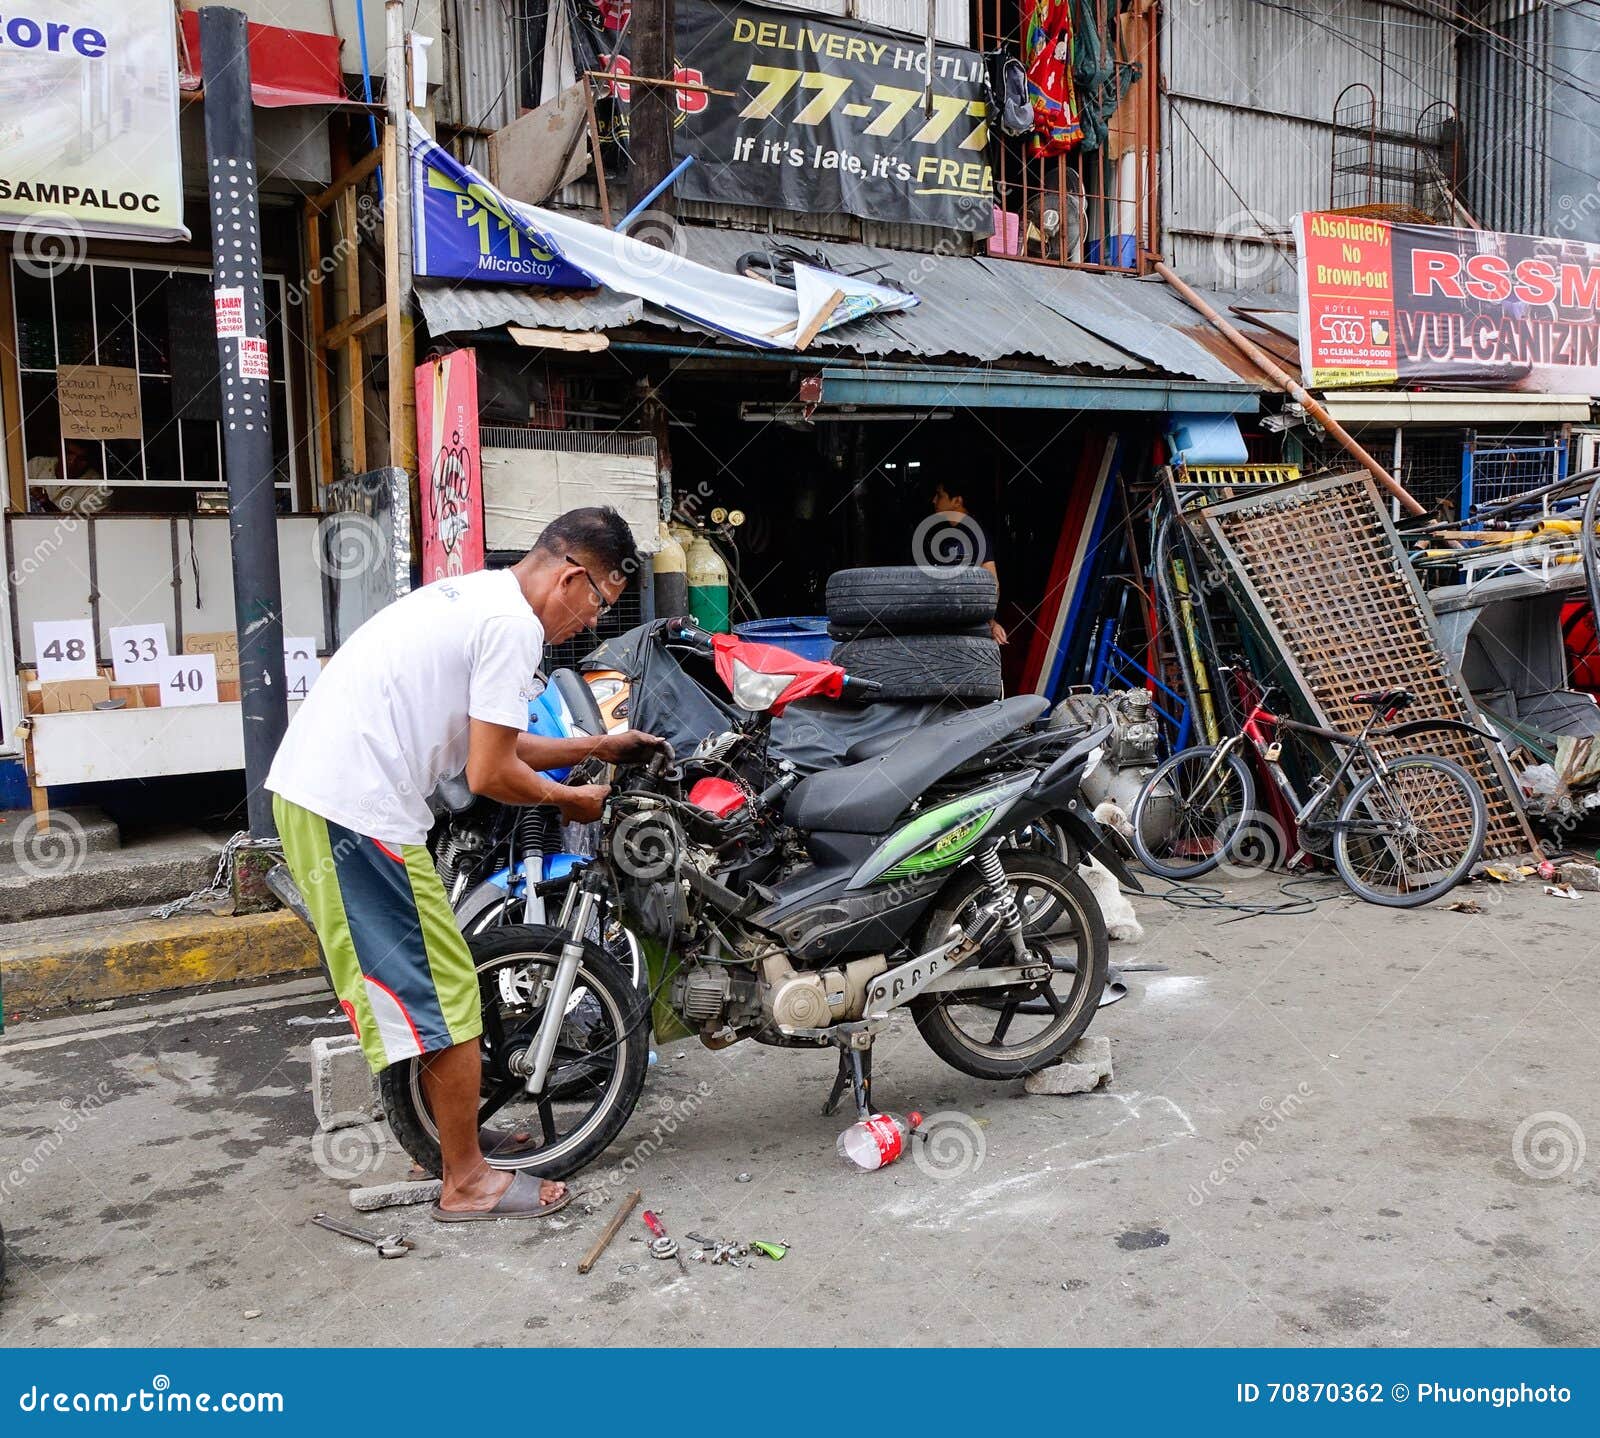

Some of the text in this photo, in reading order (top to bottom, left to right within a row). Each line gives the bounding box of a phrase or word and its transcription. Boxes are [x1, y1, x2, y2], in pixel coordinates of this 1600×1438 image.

[0, 15, 107, 58] ore
[733, 18, 888, 66] DELIVERY
[732, 137, 756, 162] If
[761, 140, 805, 167] it's
[917, 156, 993, 192] FREE
[0, 179, 160, 213] SAMPALOC
[468, 208, 553, 261] 11
[1311, 216, 1389, 247] Absolutely,
[1342, 242, 1361, 263] No
[478, 255, 555, 279] MicroStay
[1317, 264, 1389, 289] Brown-out
[1412, 249, 1600, 310] RSSM
[1325, 305, 1359, 314] HOTEL
[43, 638, 86, 662] 48
[123, 637, 159, 663] 33
[170, 668, 204, 692] 40
[286, 675, 309, 698] 4
